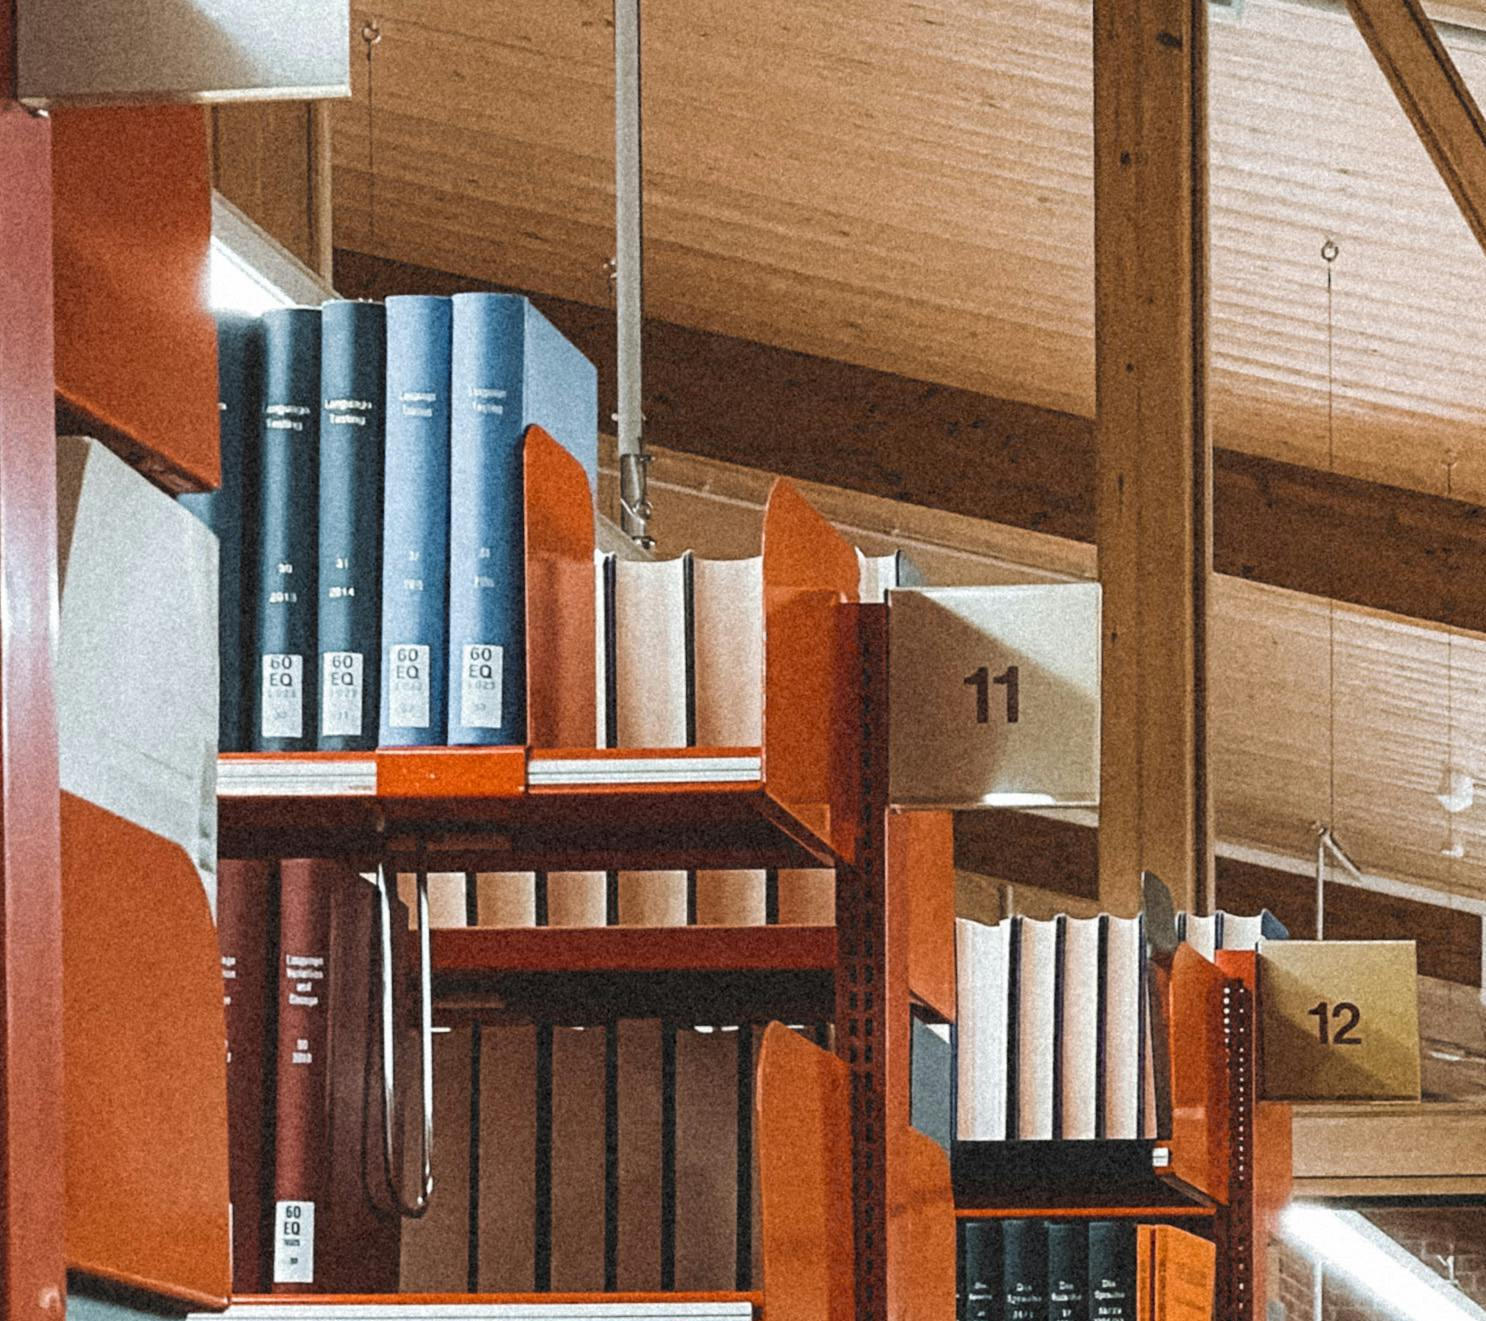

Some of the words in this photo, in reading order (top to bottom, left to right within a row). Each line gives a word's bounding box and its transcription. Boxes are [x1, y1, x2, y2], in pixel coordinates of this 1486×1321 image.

[398, 649, 418, 662] 60
[470, 648, 492, 661] 60
[270, 656, 292, 669] 60
[332, 655, 353, 669] 60
[397, 665, 419, 679] EQ
[469, 664, 492, 678] EQ
[270, 673, 293, 687] EQ
[331, 672, 353, 686] EQ
[963, 666, 1019, 723] 11
[1308, 1002, 1362, 1044] 12
[286, 1205, 302, 1219] 60
[283, 1222, 300, 1236] EQ
